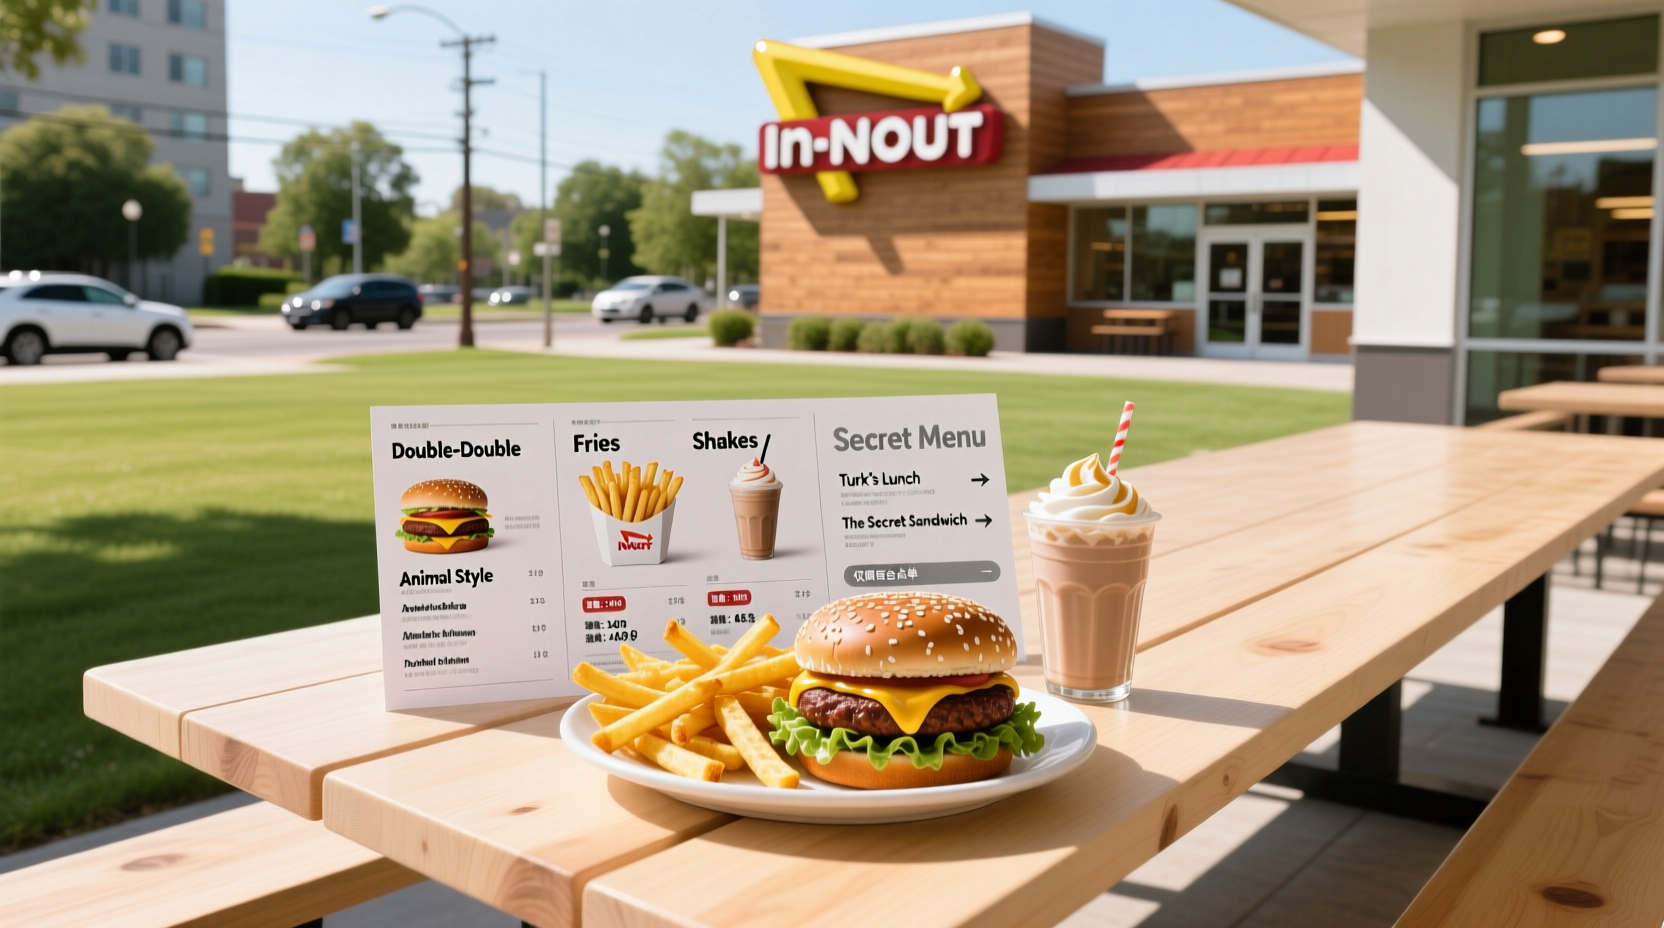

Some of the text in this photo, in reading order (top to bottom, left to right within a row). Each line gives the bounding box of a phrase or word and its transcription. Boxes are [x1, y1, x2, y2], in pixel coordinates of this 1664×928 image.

[764, 111, 984, 170] In-NOUT
[573, 433, 621, 453] Fries
[692, 431, 758, 450] Shakes
[833, 424, 987, 452] Secret Menu
[392, 439, 521, 459] Double-Double
[839, 471, 921, 487] Turk's Lunch
[842, 516, 865, 530] The
[908, 512, 968, 527] Sandwich
[399, 567, 494, 588] Animal Style
